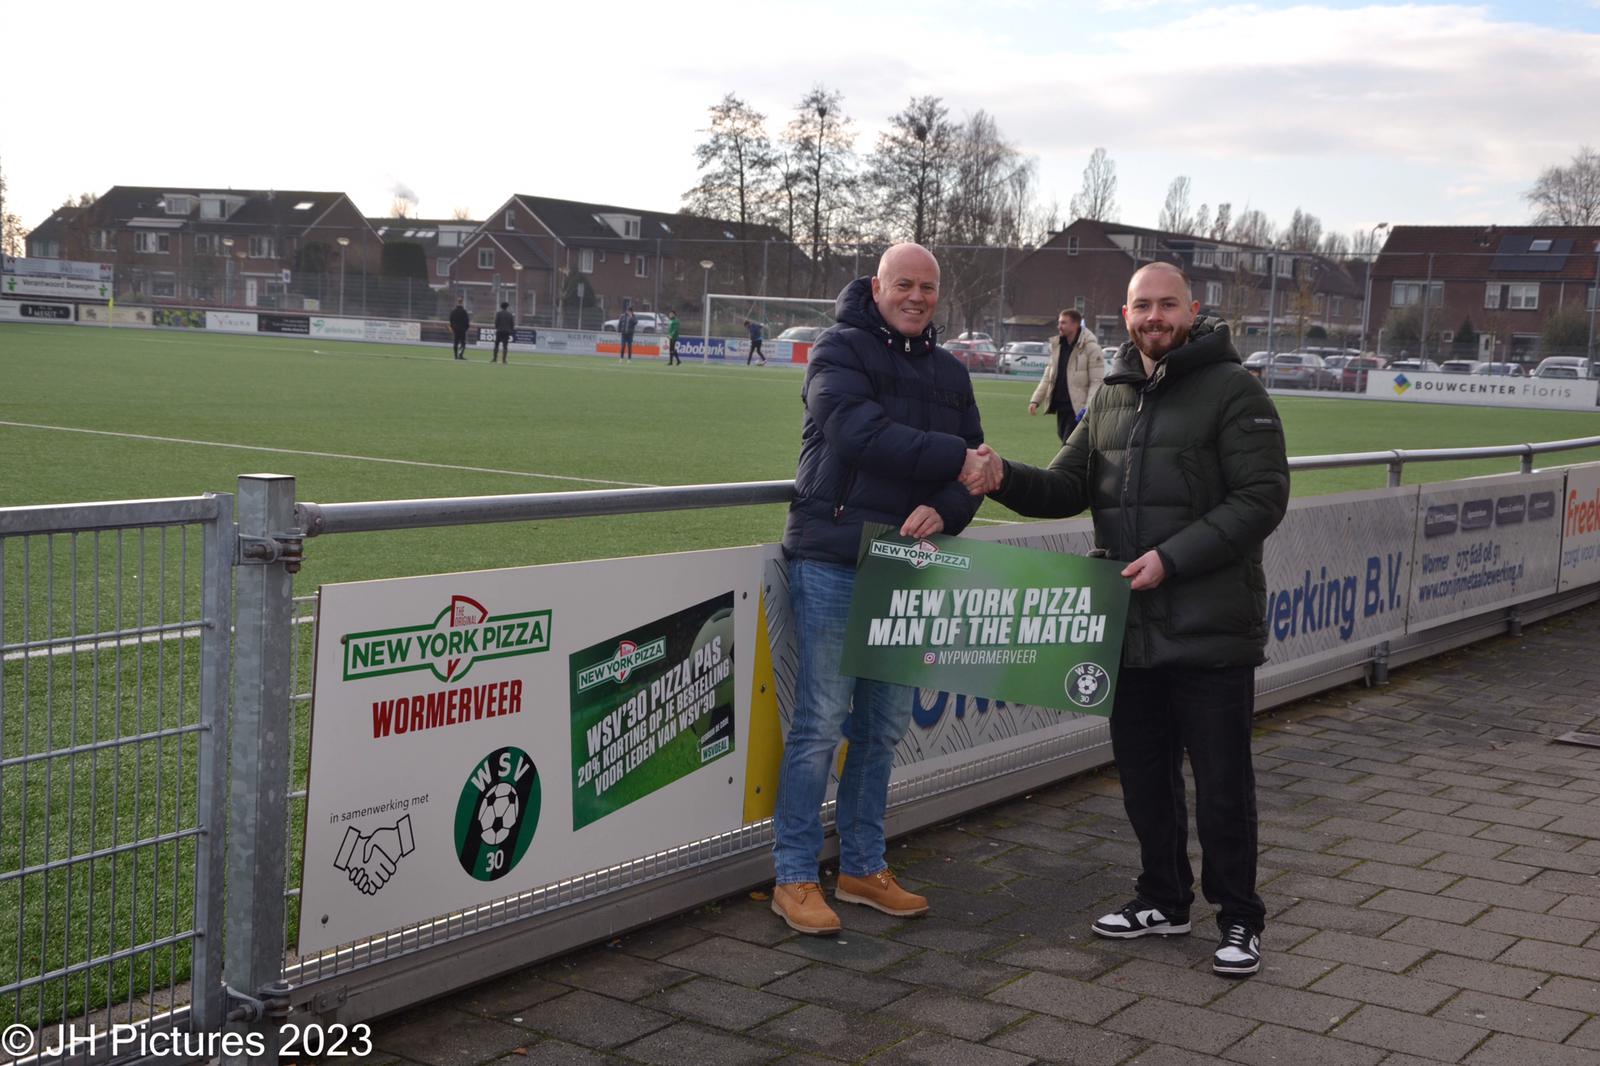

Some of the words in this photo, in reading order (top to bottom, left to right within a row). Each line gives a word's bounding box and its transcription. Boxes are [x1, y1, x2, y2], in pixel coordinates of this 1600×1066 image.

[674, 341, 724, 356] Rabobnk
[1415, 380, 1516, 395] BOUWCENTER
[1522, 384, 1572, 398] Floris
[873, 542, 902, 556] NEW
[902, 547, 933, 562] YORK
[934, 553, 968, 568] PIZZA
[1364, 552, 1401, 617] B.V.
[889, 589, 945, 617] NEW
[953, 588, 1018, 616] YORK
[1022, 586, 1092, 615] PIZZA
[352, 637, 413, 669] NEW
[416, 629, 478, 660] YORK
[482, 620, 544, 651] PIZZA
[867, 617, 926, 646] MAN
[930, 617, 964, 646] OF
[967, 616, 1014, 645] THE
[1017, 614, 1107, 644] MATCH
[580, 668, 605, 685] NEW
[604, 656, 634, 678] YORK
[634, 645, 663, 667] PIZZA
[938, 649, 1037, 665] NYPWORMERVEER
[1074, 665, 1104, 678] WSV
[651, 658, 691, 711] PIZZA
[694, 635, 722, 678] PAS
[372, 679, 523, 739] WORMERVEER
[1080, 696, 1090, 704] 30
[578, 758, 600, 788] 20%
[603, 723, 648, 769] KORTING
[650, 711, 663, 734] OP
[665, 702, 675, 723] JE
[677, 659, 730, 713] BESTELLING
[471, 752, 530, 793] WSV
[595, 761, 624, 796] VOOR
[626, 738, 656, 773] LEDEN
[658, 721, 677, 749] VAN
[330, 813, 340, 824] in
[341, 797, 409, 822] samenwerking
[411, 793, 430, 807] met
[485, 850, 504, 872] 30
